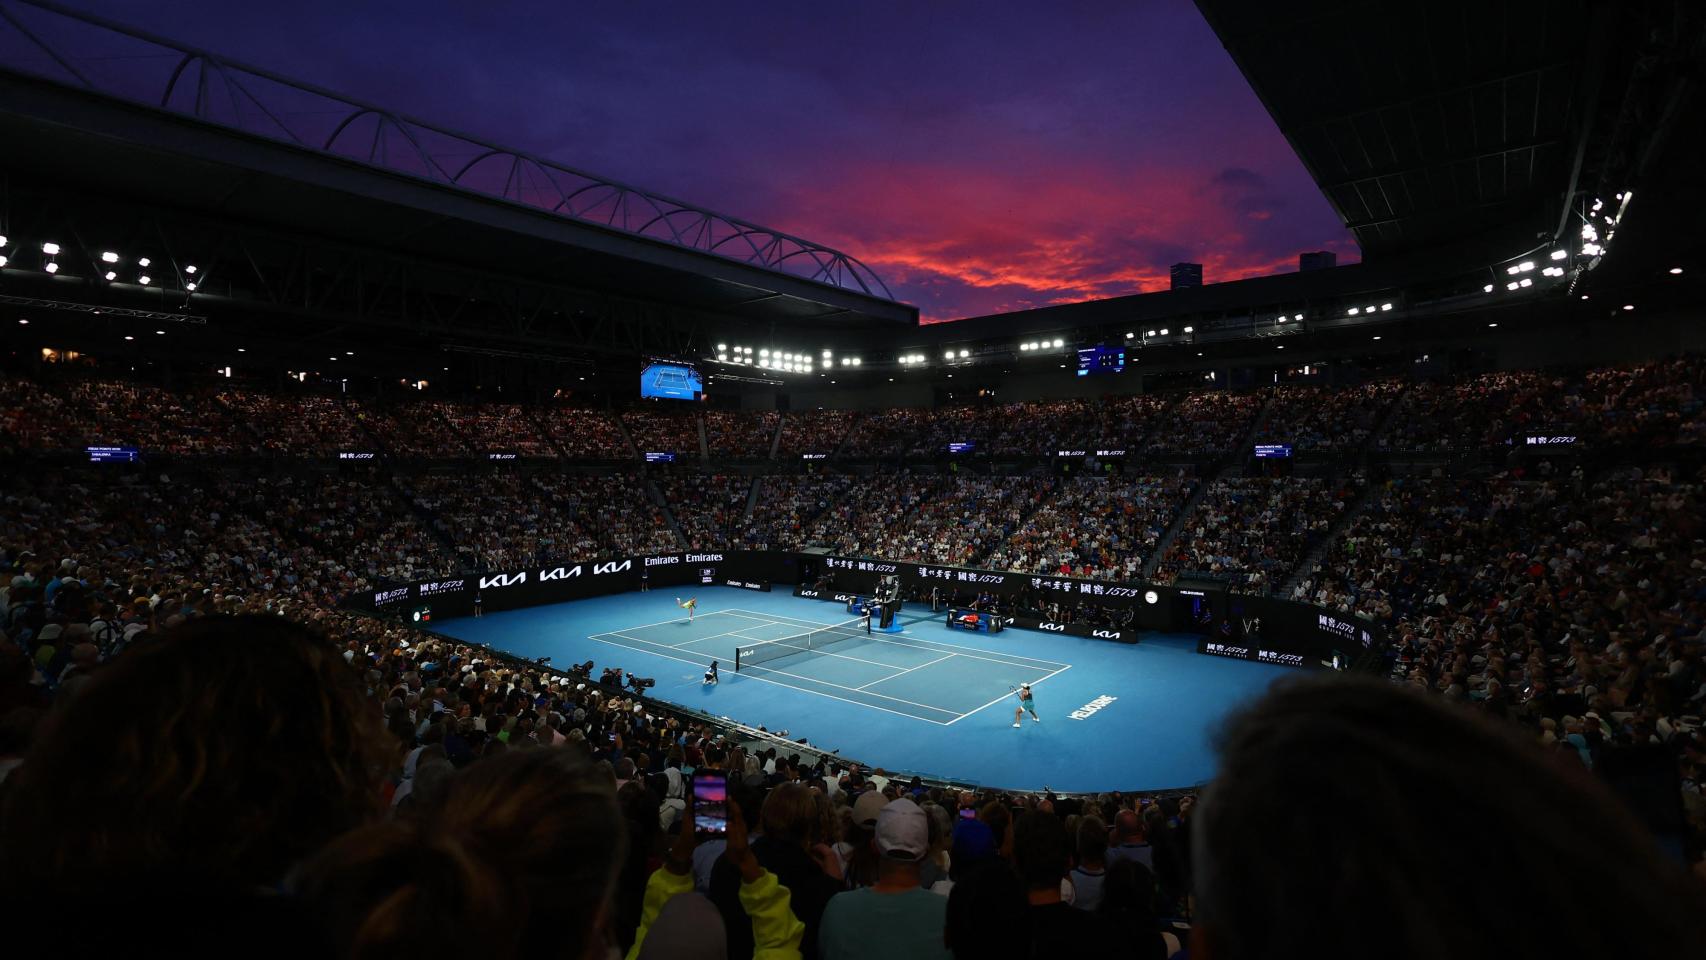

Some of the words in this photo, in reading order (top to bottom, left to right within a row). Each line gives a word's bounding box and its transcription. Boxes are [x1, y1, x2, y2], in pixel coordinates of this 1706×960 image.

[644, 556, 679, 567] Emirates
[685, 553, 723, 563] Emirates
[593, 559, 631, 575] KIA
[539, 565, 582, 582] KIA
[479, 571, 527, 589] KIA
[1039, 622, 1065, 632] KIA
[1091, 629, 1120, 640] KIA
